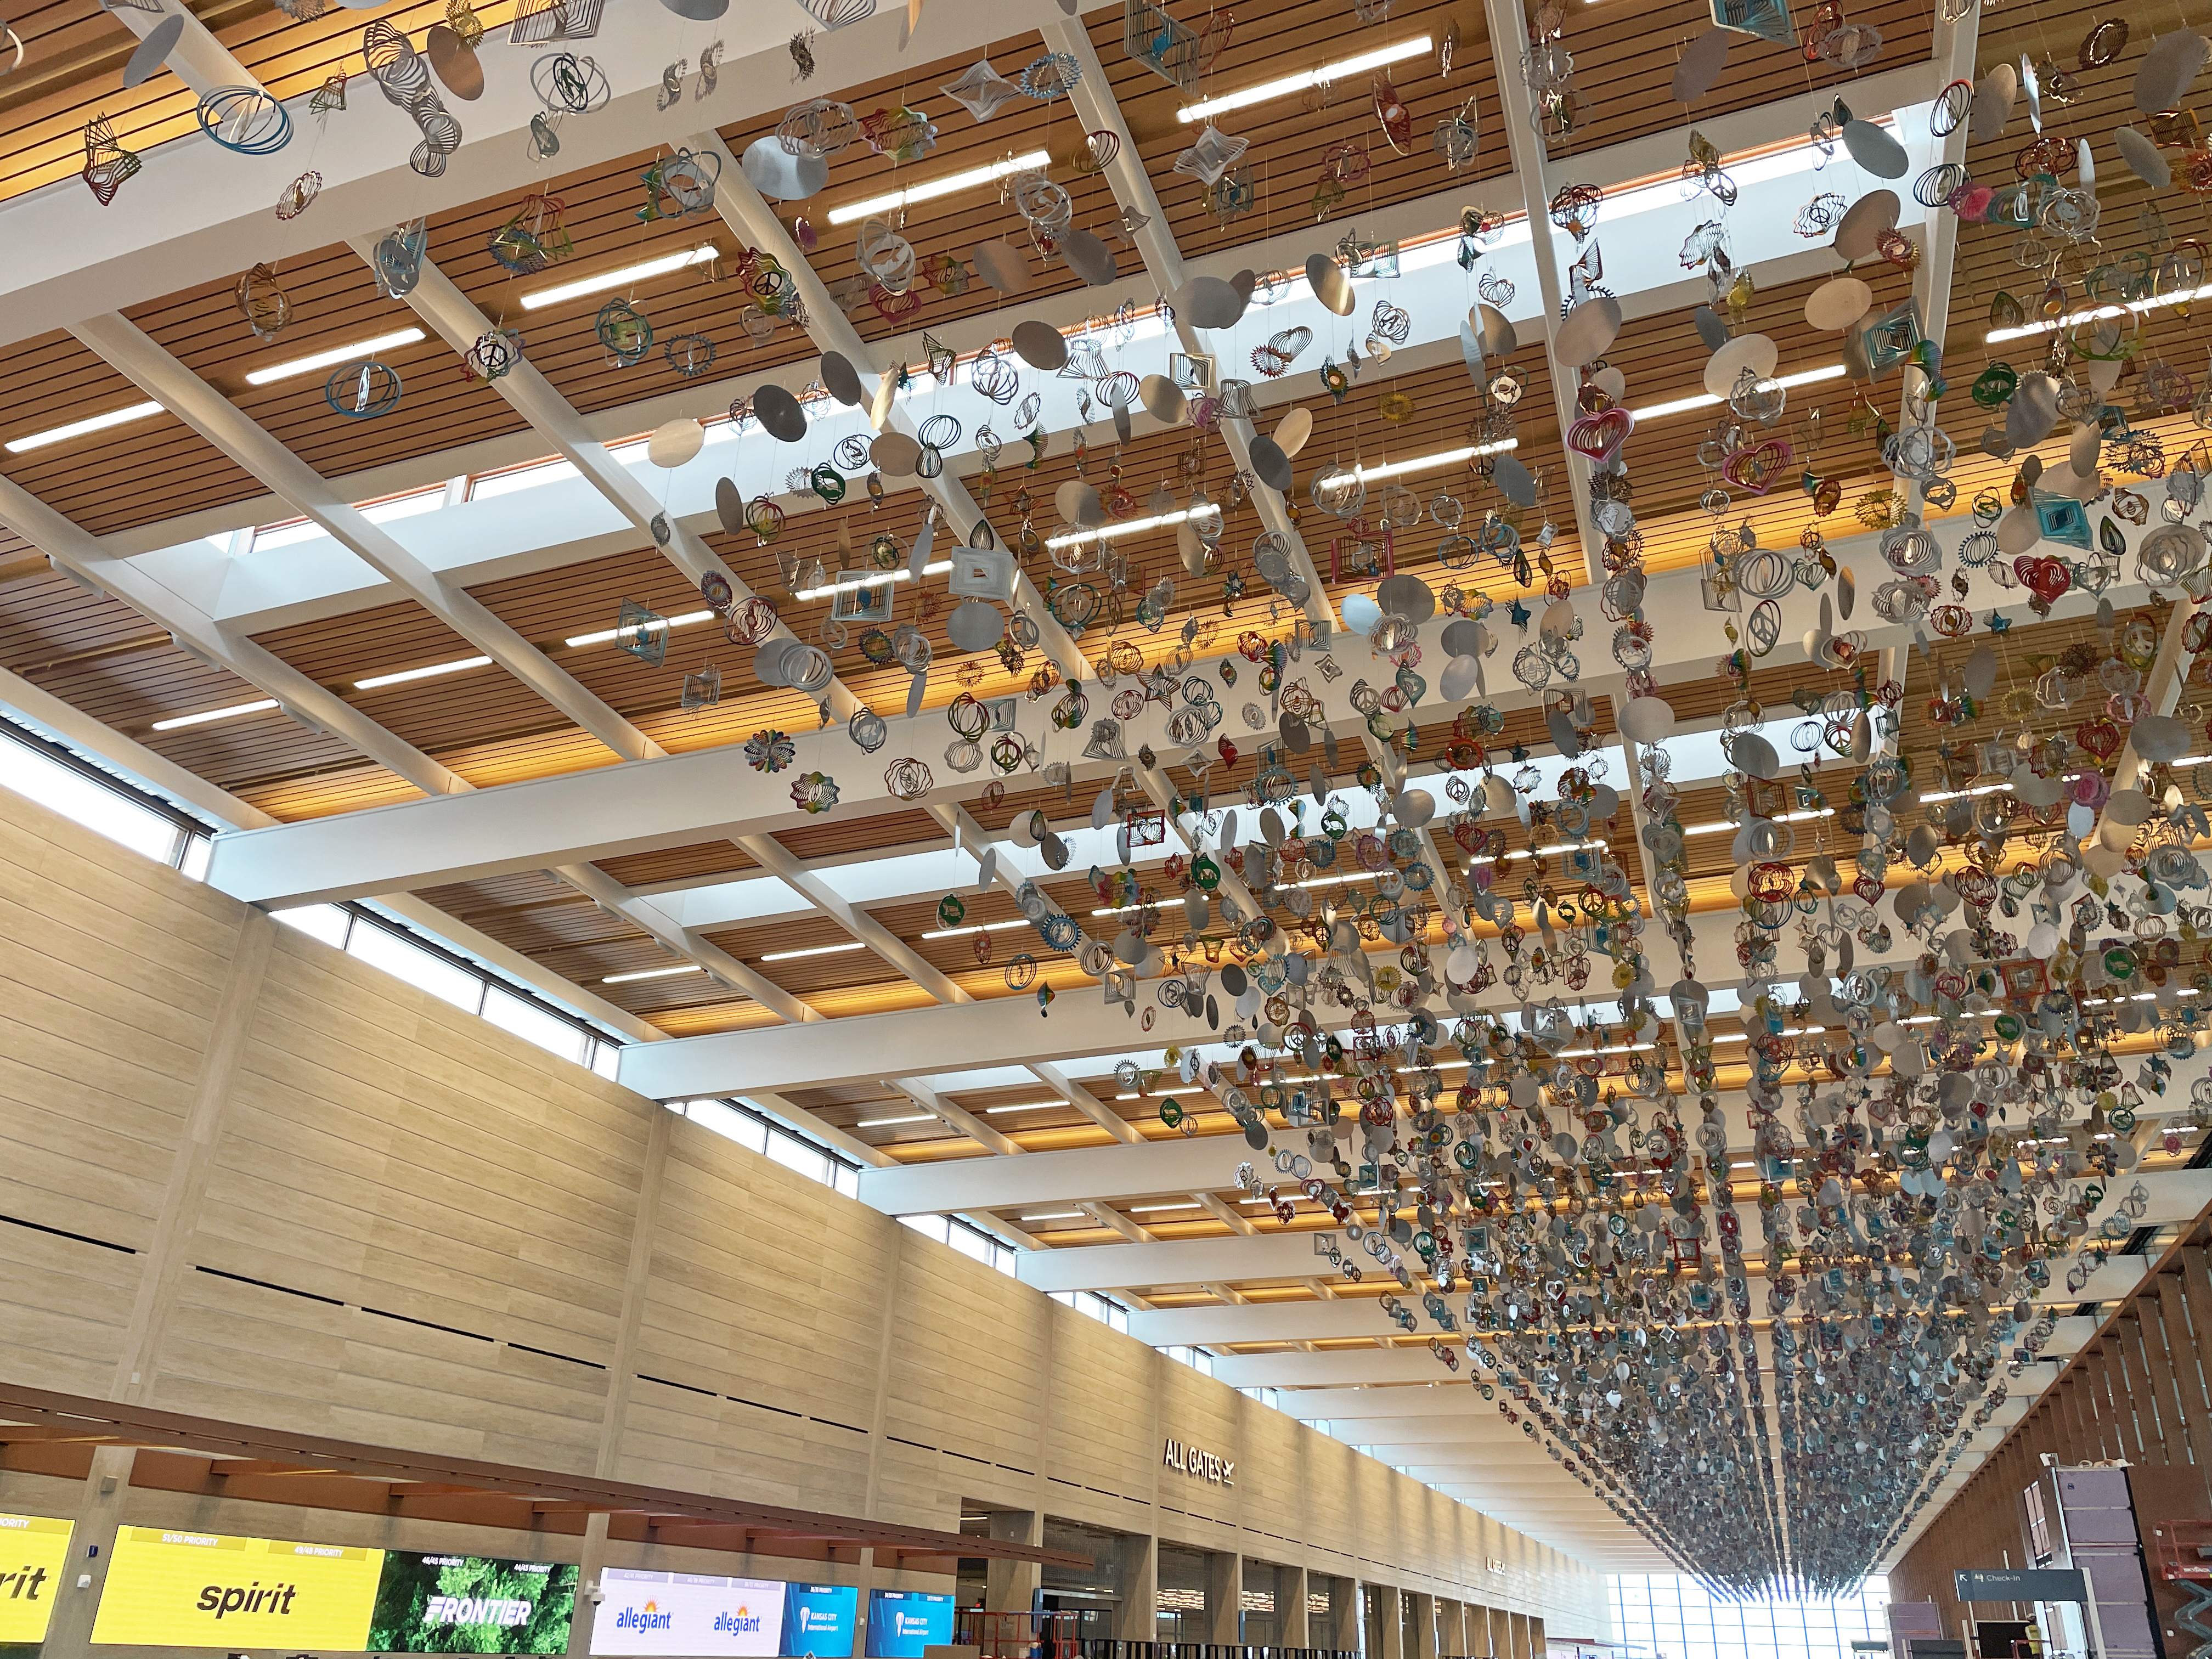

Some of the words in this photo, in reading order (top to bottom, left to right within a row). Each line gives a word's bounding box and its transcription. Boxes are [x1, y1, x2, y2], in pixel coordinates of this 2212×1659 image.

[1164, 1438, 1186, 1470] ALL
[1188, 1446, 1221, 1481] GATES
[162, 1533, 183, 1543] 51/50
[184, 1536, 218, 1546] PRIORITY
[295, 1545, 313, 1554] 49/48
[314, 1548, 344, 1557] PRIORITY
[439, 1558, 465, 1567] PRIORITY
[529, 1564, 551, 1573] PRIORITY
[196, 1581, 296, 1619] spirit
[423, 1596, 532, 1626] FRONTIER
[811, 1612, 827, 1621] KANSAS
[828, 1612, 837, 1621] CITY
[617, 1607, 672, 1634] allegiant
[714, 1611, 760, 1637] allegiant
[905, 1617, 919, 1626] KANSAS
[919, 1617, 928, 1626] CITY
